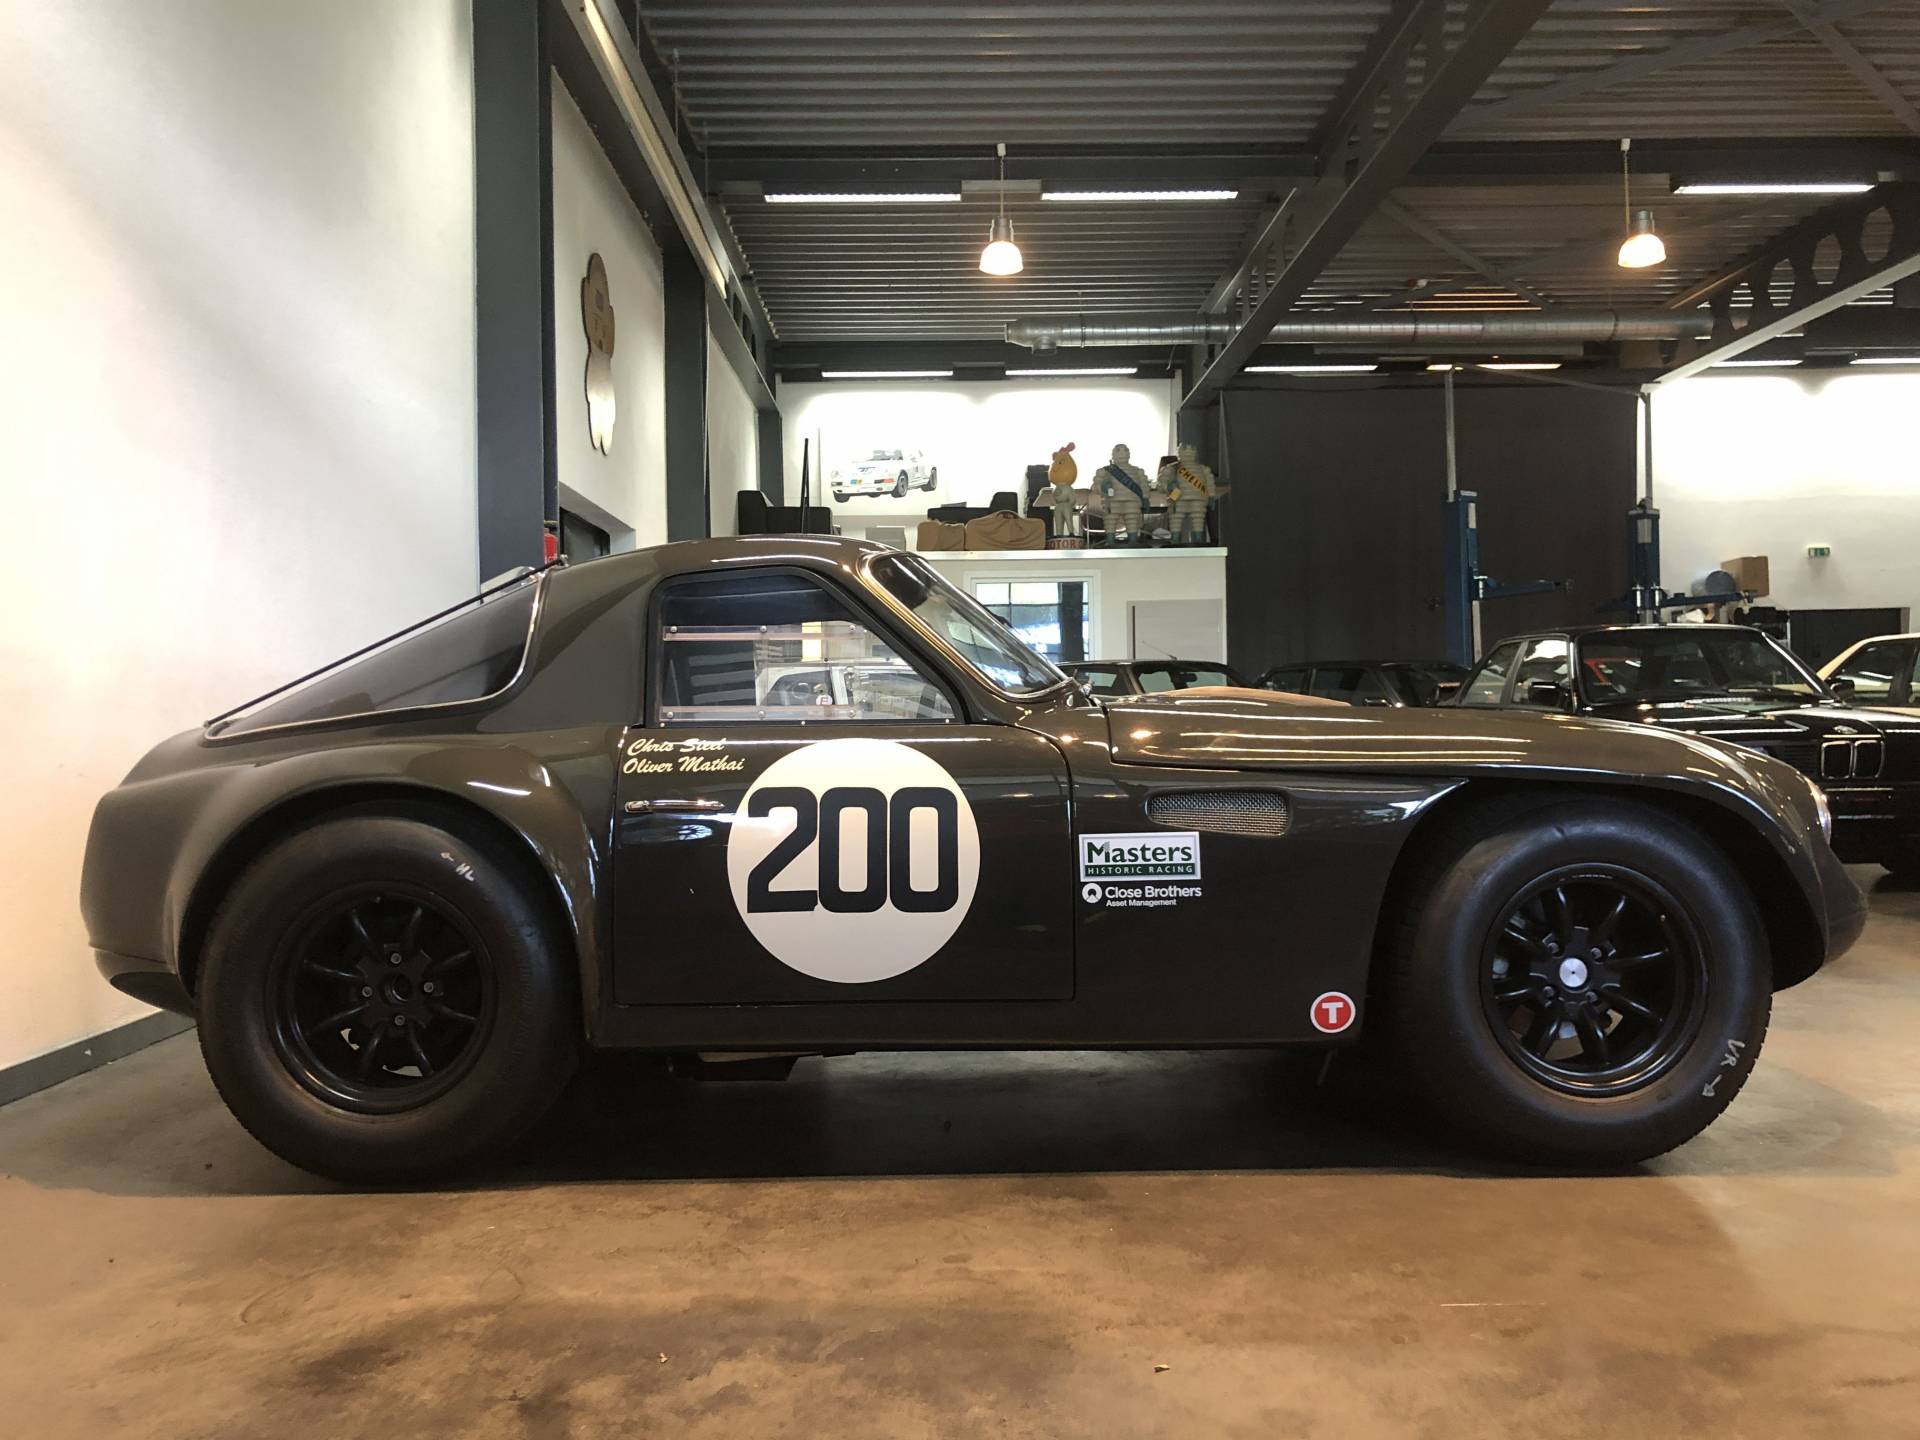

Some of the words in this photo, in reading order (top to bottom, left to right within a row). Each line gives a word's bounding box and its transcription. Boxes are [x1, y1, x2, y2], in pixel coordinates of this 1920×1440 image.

[1179, 467, 1206, 495] CHELIN
[627, 738, 674, 756] Chris
[623, 758, 673, 774] Oliver
[678, 755, 746, 772] Mathai
[747, 786, 959, 914] 200
[1087, 841, 1193, 863] Masters
[1088, 866, 1145, 875] HISTORIC
[1149, 865, 1193, 873] RACING
[1105, 886, 1143, 899] Close
[1144, 885, 1202, 898] Brothers
[1128, 899, 1177, 908] Management
[1321, 1001, 1344, 1024] T
